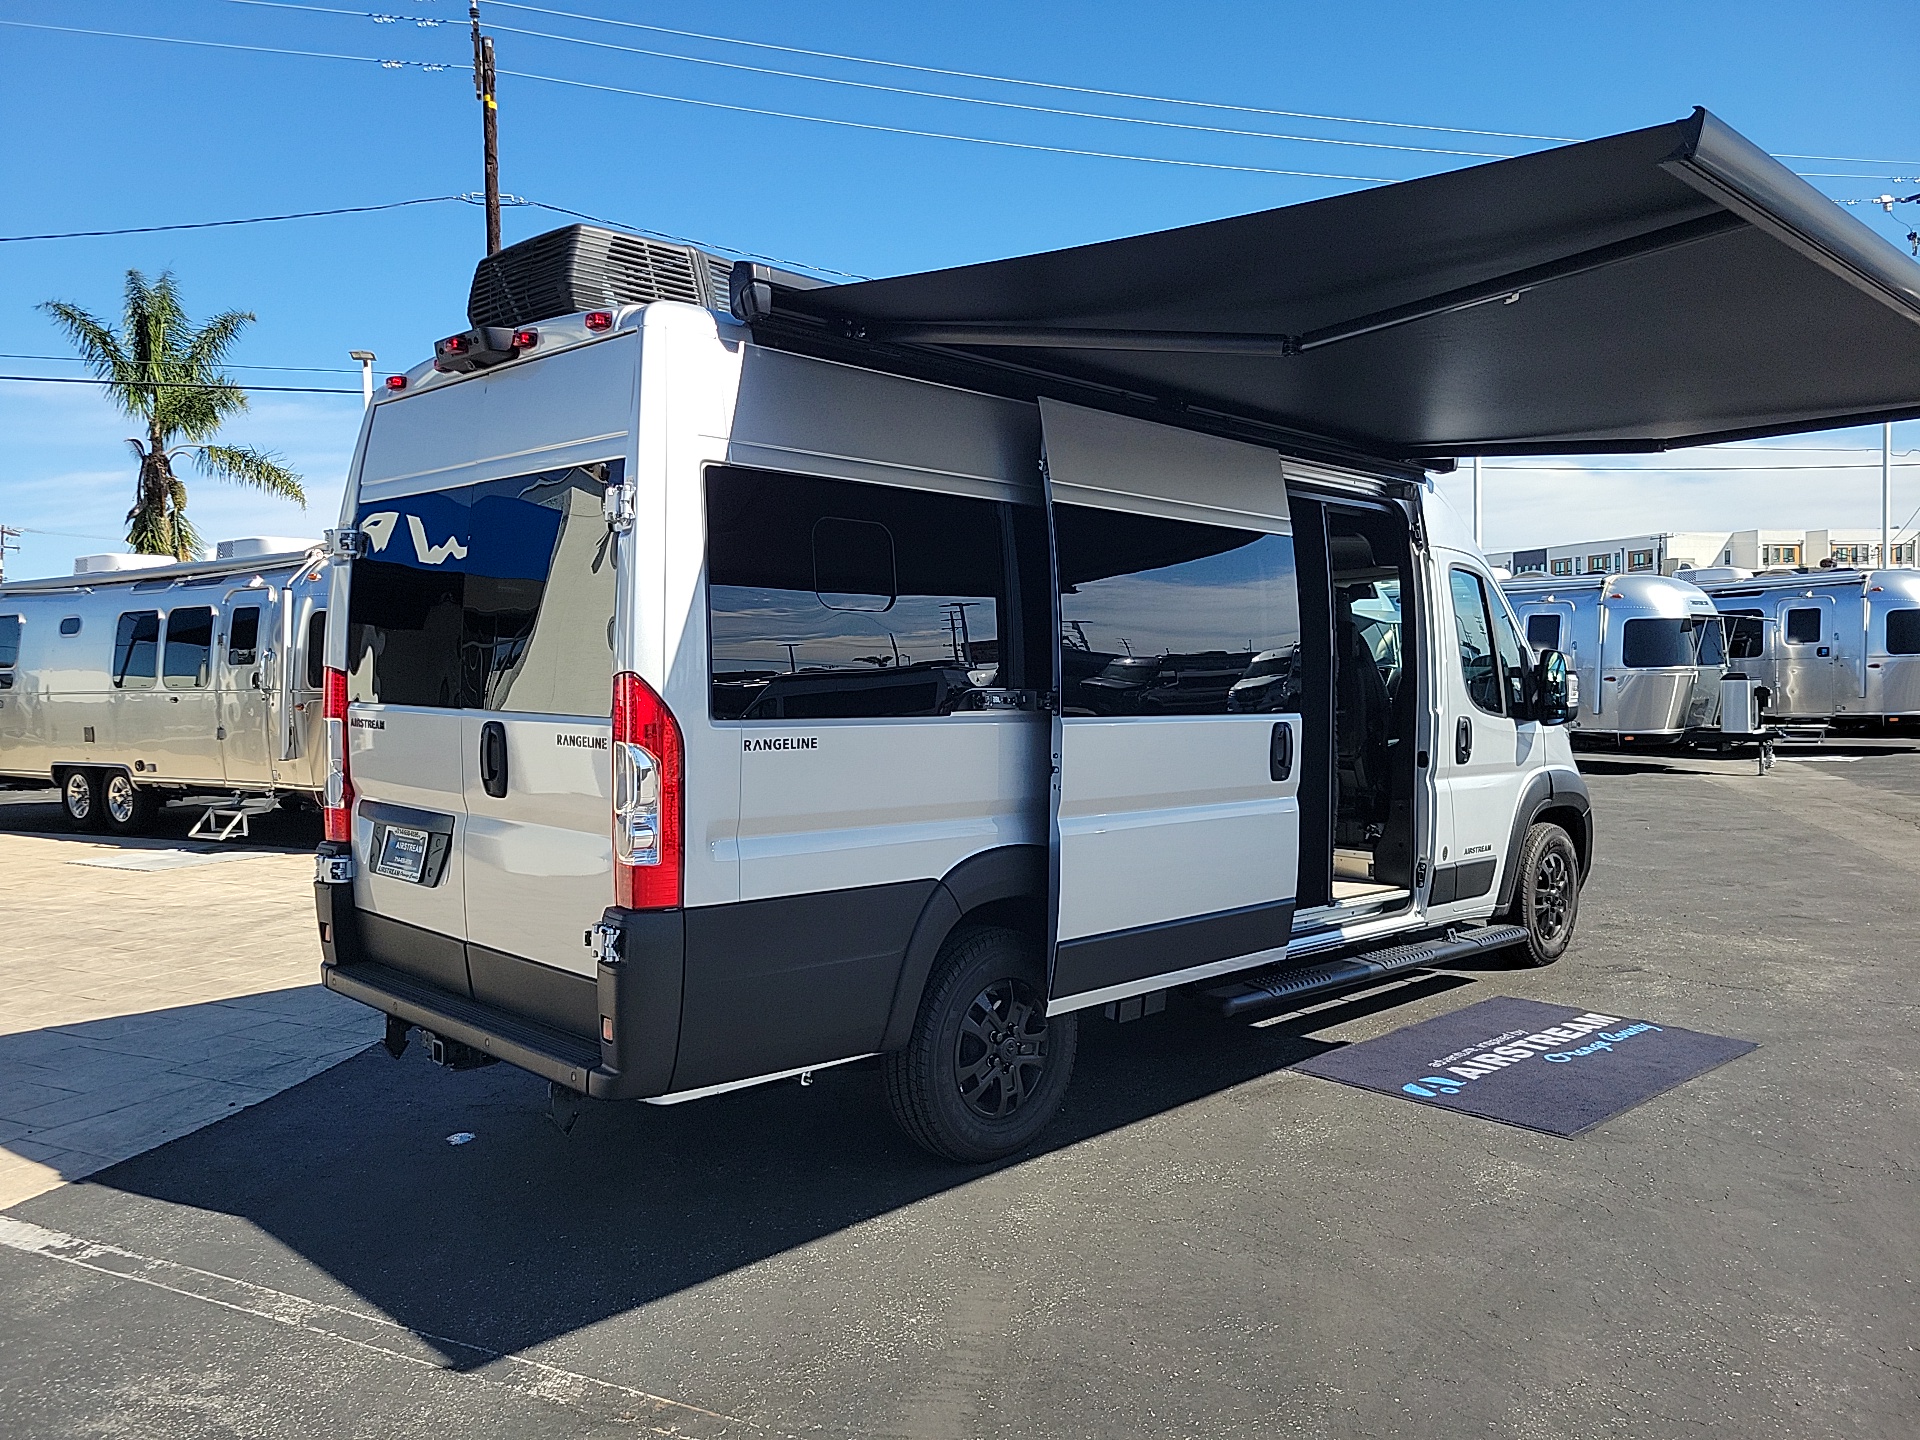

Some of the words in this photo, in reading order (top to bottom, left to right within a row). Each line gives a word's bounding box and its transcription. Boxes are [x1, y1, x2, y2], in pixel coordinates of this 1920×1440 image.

[351, 718, 385, 730] AIRSTREAM
[557, 734, 607, 749] RANGELINE
[744, 737, 817, 752] RANGELINE
[395, 841, 422, 853] AIRSTREAM
[1463, 844, 1492, 856] AIRSTREAM
[1447, 1012, 1622, 1080] AIRSTREAM
[1544, 1040, 1613, 1064] Orange
[1597, 1022, 1664, 1042] County
